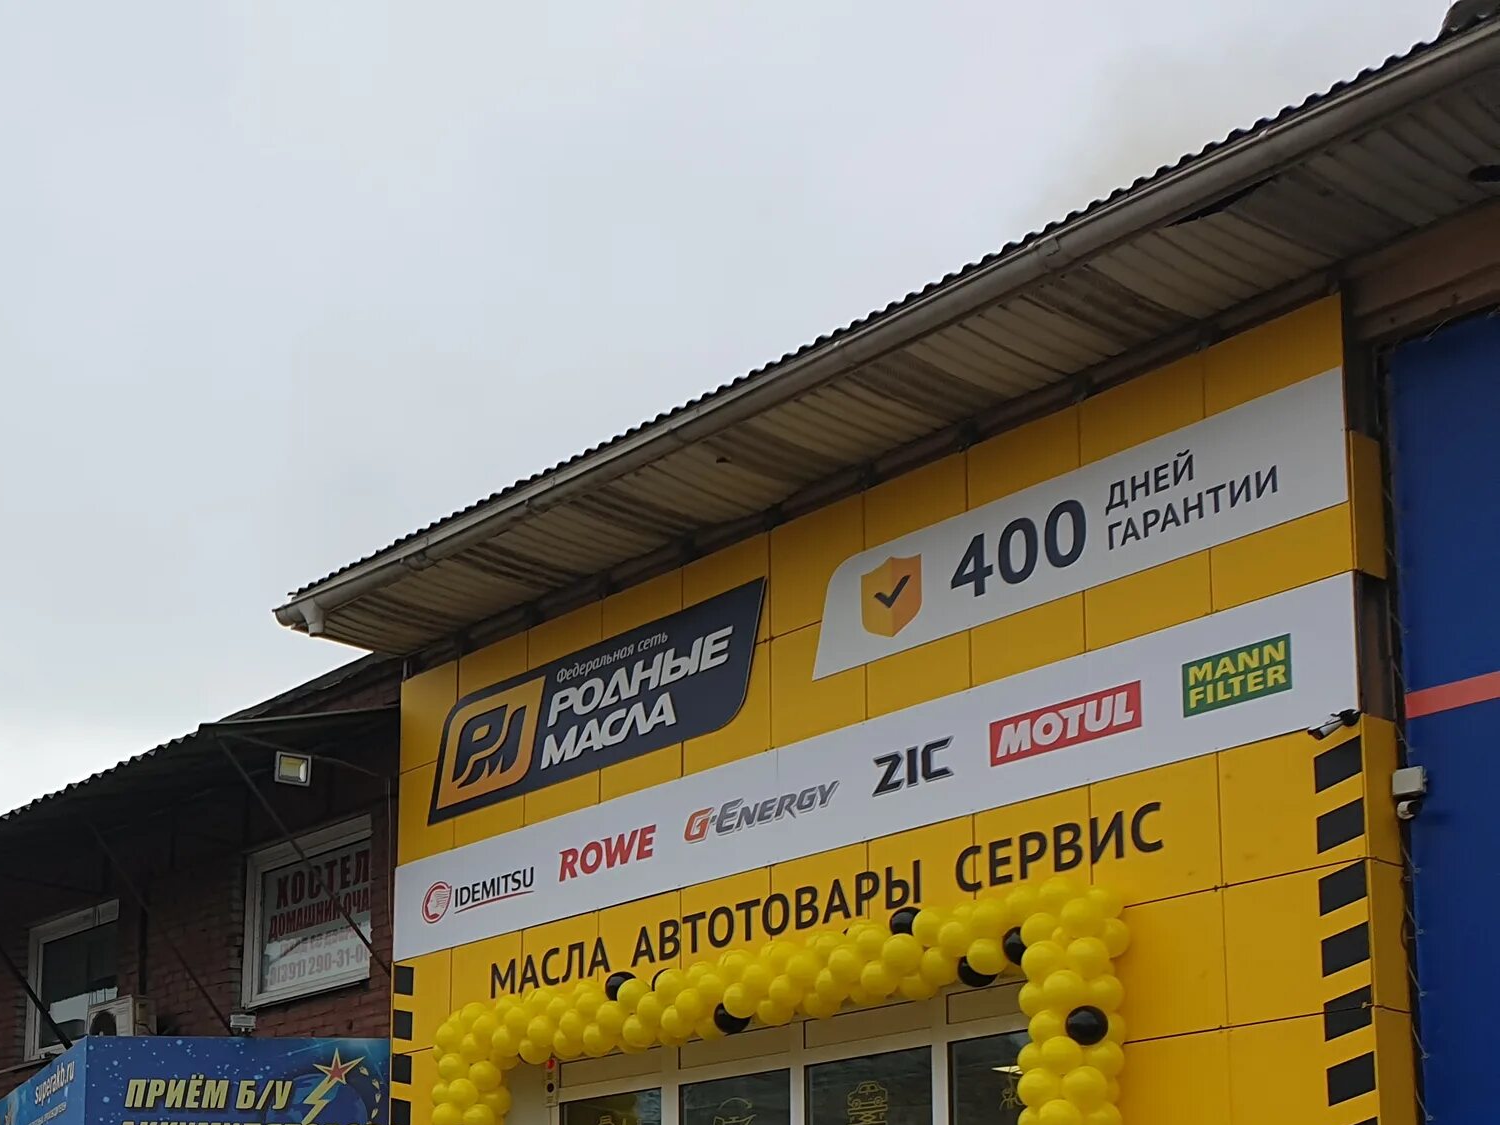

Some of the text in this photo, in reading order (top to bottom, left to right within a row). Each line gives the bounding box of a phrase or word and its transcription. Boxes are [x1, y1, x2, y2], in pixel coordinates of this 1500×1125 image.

[1105, 448, 1195, 516] ДНЕЙ
[1108, 465, 1279, 550] ГАРАНТИИ
[950, 499, 1087, 597] 400
[547, 625, 734, 727] РОДНЫЕ
[556, 631, 668, 683] Федеральная сеть
[1188, 639, 1286, 687] MANN
[1189, 663, 1287, 709] FILTER
[540, 692, 677, 770] МАСЛА
[996, 691, 1135, 758] MOTUL
[871, 735, 955, 797] ZIC
[558, 824, 657, 882] ROWE
[454, 866, 535, 908] IDEMITSU
[490, 801, 1165, 999] МАСЛА АВТОТОВАРЫ СЕРВИС
[34, 1060, 76, 1107] superakb.ru
[124, 1074, 294, 1110] ПРИЁМ Б/У
